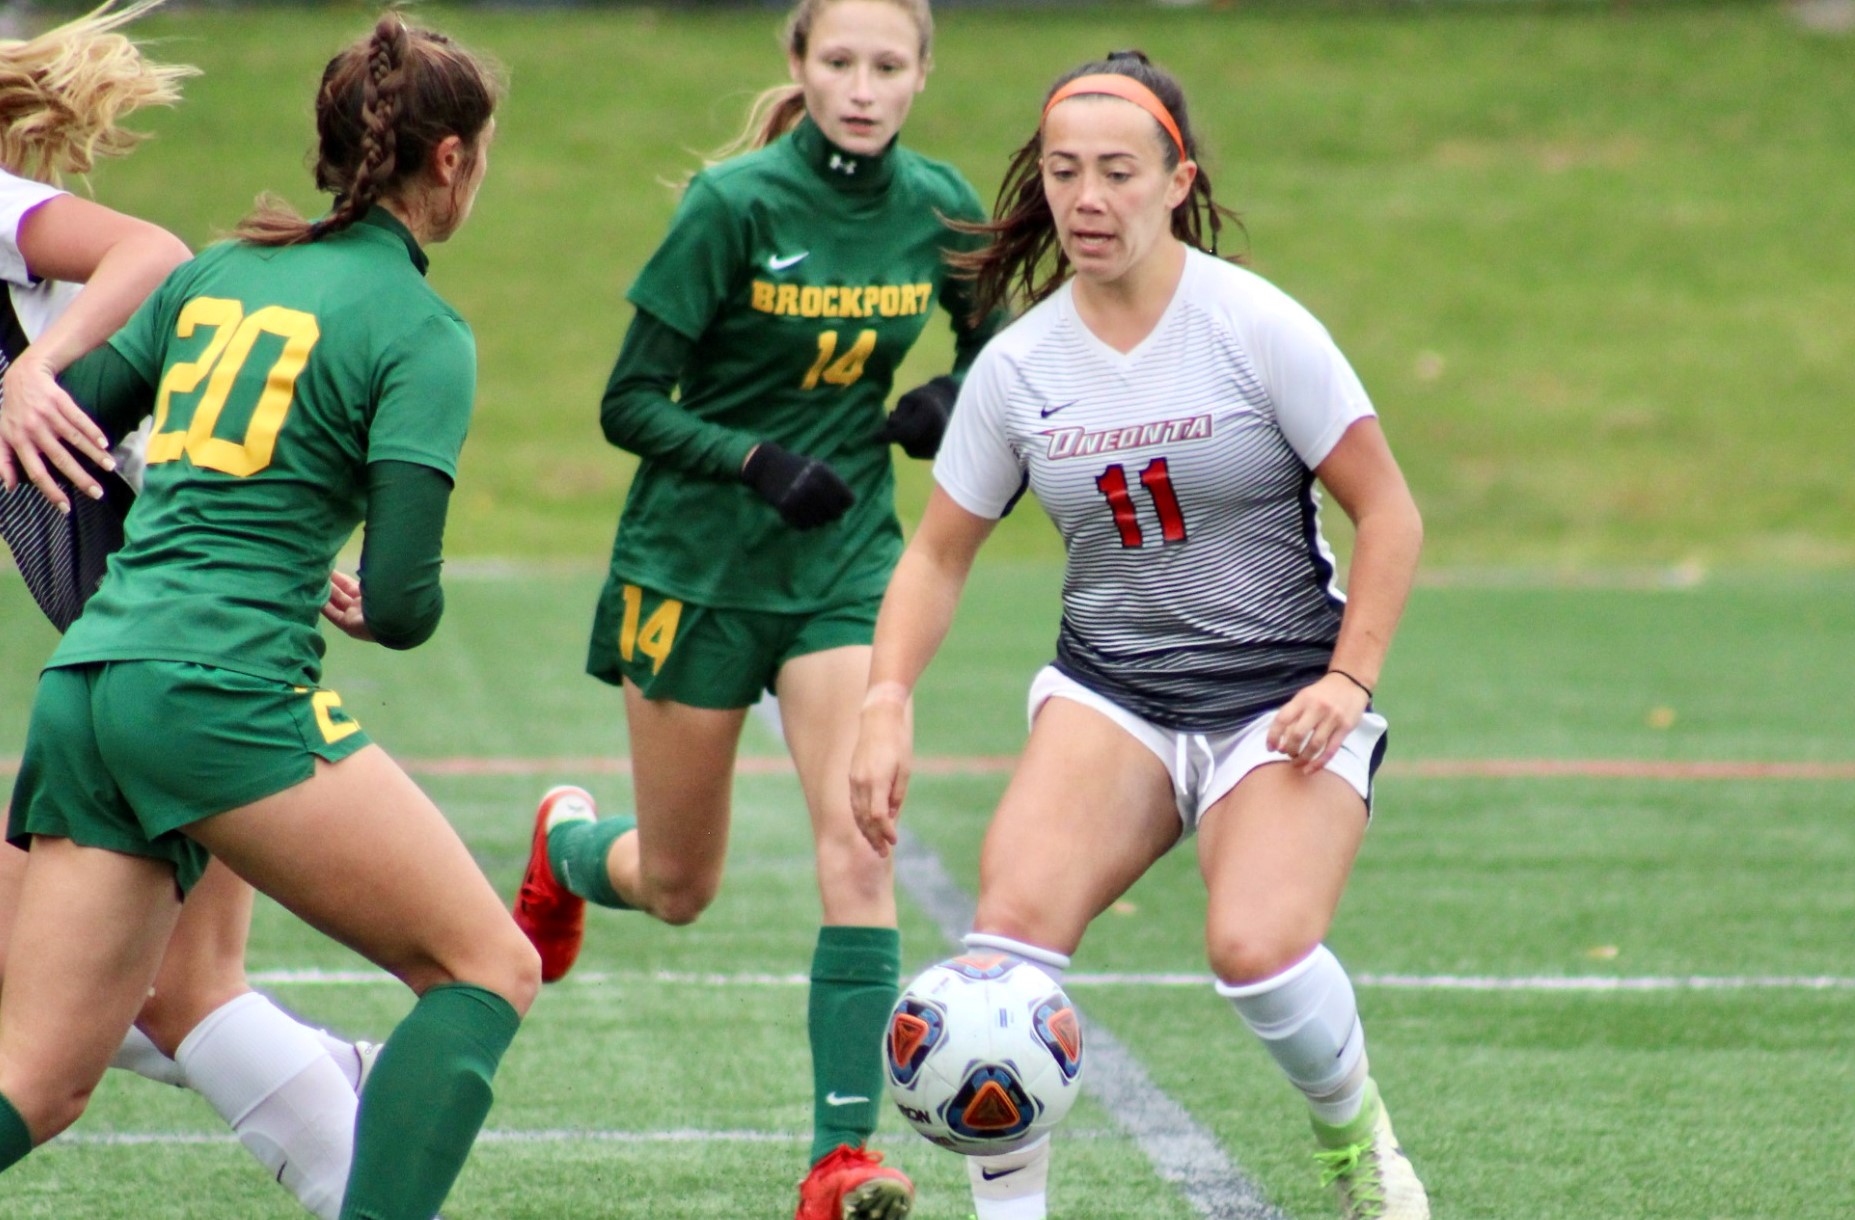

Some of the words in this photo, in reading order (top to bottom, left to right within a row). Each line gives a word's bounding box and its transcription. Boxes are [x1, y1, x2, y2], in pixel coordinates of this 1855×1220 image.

[752, 280, 932, 317] BROCKPORT
[144, 297, 320, 477] 20
[802, 329, 877, 390] 14
[1046, 414, 1213, 460] ONEONTA
[1094, 456, 1187, 548] 11
[619, 584, 683, 676] 14
